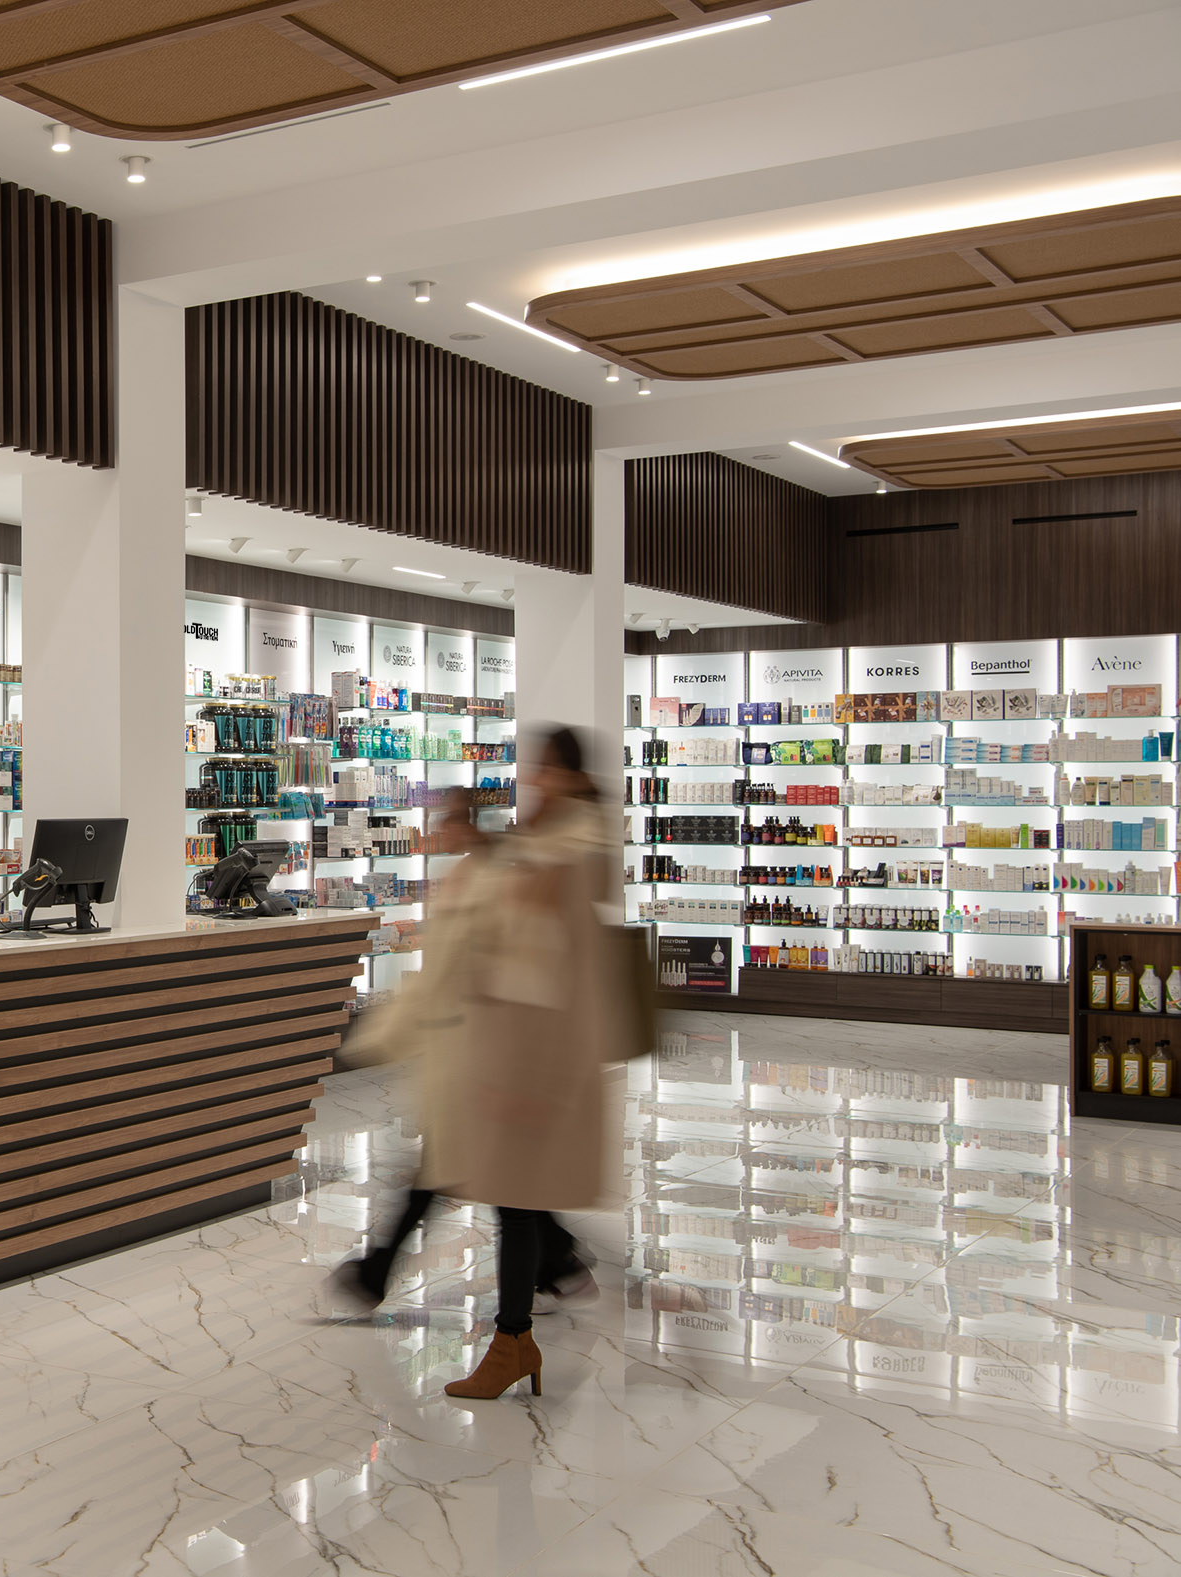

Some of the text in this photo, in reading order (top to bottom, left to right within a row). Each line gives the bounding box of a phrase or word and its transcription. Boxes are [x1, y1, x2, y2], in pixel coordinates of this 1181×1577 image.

[263, 632, 298, 650] Στοματική
[392, 654, 416, 667] SIBERICA
[970, 659, 1031, 672] Bepanthol
[1091, 655, 1142, 671] Avène
[781, 669, 824, 678] APIVITA
[866, 666, 920, 677] KORRES
[673, 674, 726, 684] FREZYDERM
